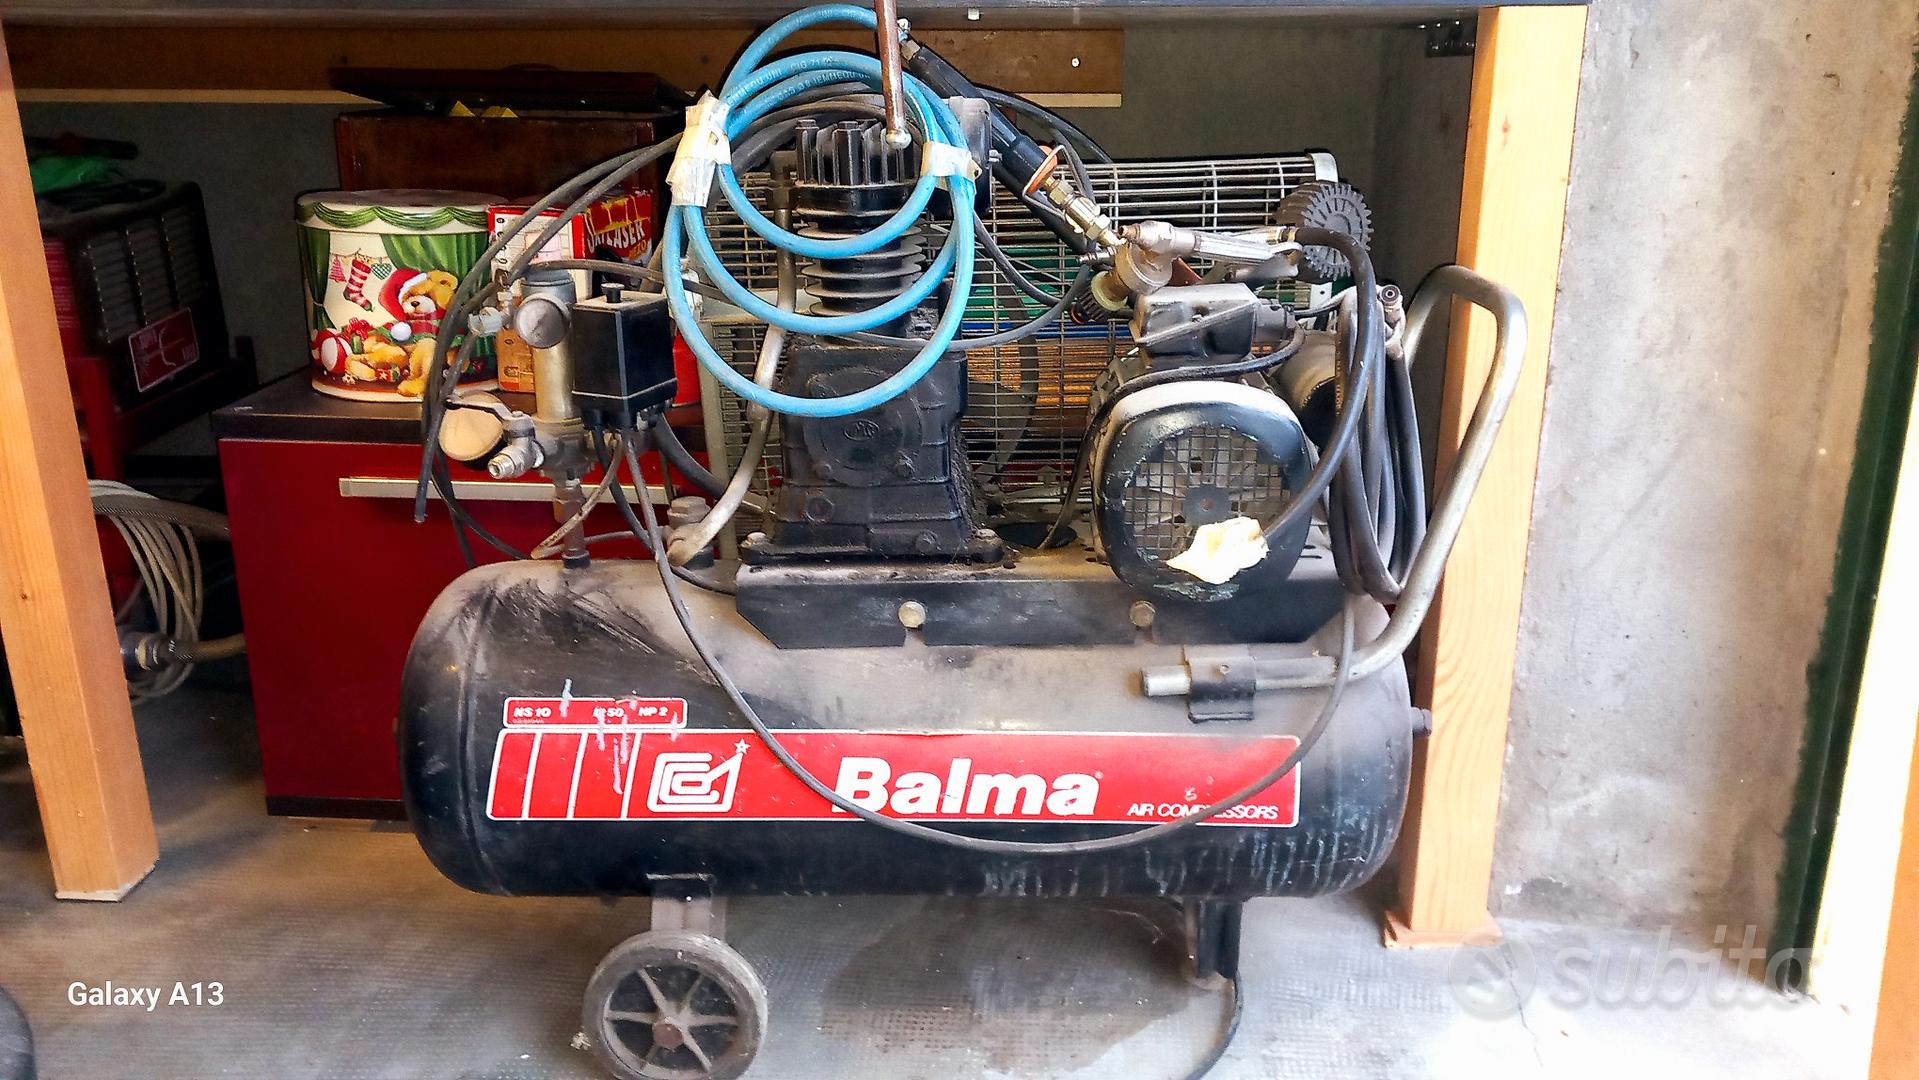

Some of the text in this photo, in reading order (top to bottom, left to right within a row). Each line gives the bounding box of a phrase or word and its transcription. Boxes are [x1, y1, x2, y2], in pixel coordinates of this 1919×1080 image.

[535, 706, 552, 718] 10
[607, 707, 625, 718] 50
[658, 706, 669, 717] 2
[831, 755, 1101, 817] Balma
[1126, 802, 1155, 817] AIR
